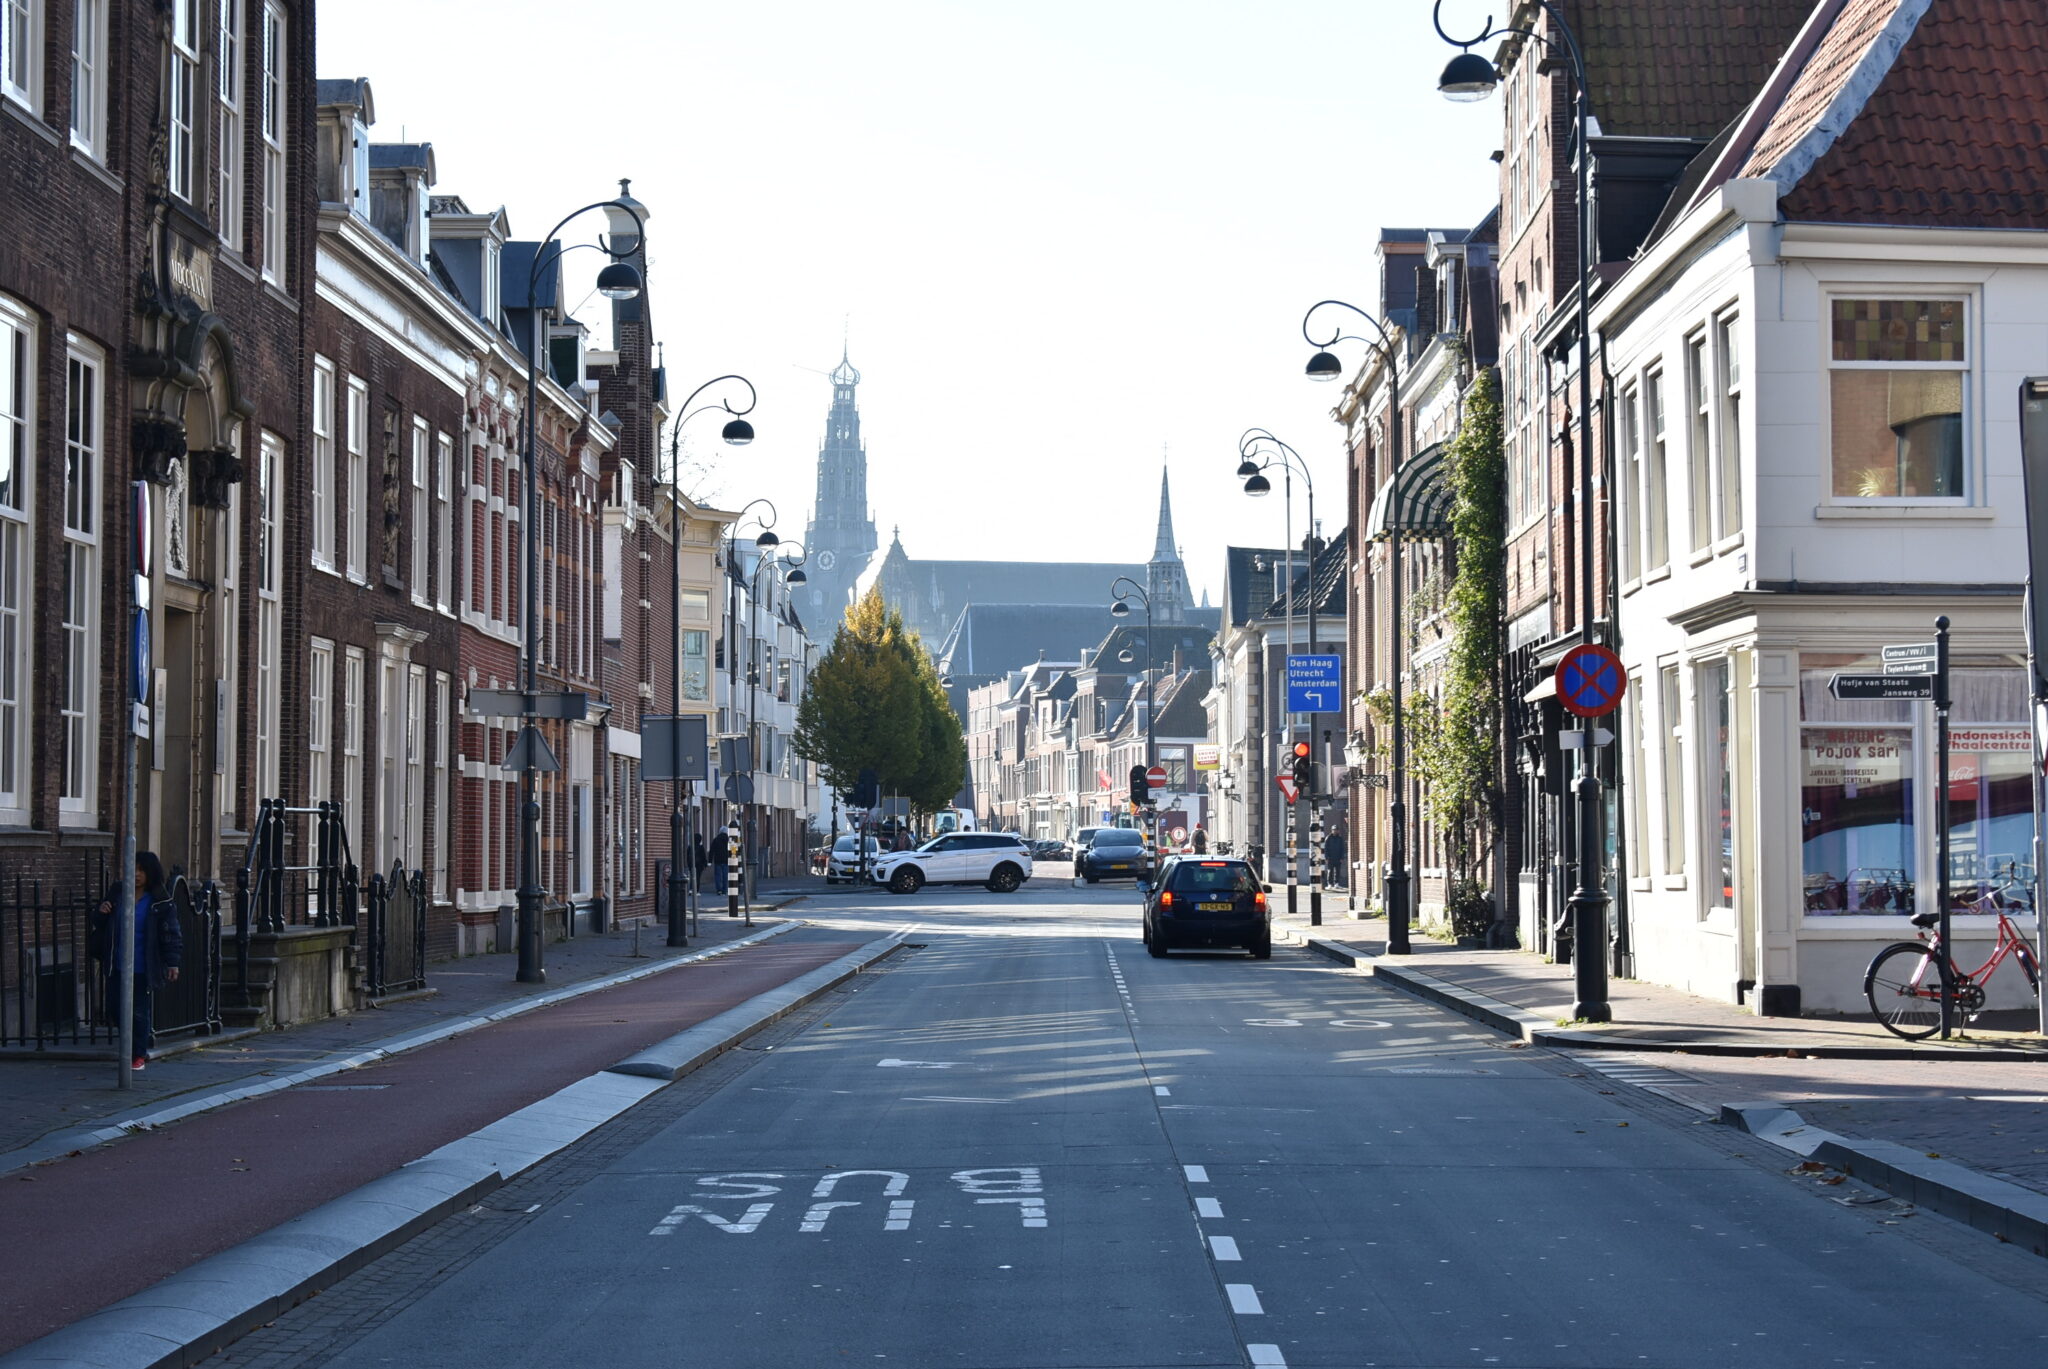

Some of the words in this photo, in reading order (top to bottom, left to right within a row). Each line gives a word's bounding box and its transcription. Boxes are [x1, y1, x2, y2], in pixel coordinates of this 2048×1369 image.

[171, 258, 206, 298] MDCCXXX
[1289, 659, 1307, 667] Den
[1310, 659, 1333, 668] Haag
[1289, 669, 1324, 677] Utrecht
[1840, 679, 1863, 688] Hofje
[1882, 689, 1918, 697] Jansweg
[1946, 731, 2031, 740] Indonesisch
[690, 1167, 1043, 1199] BUS
